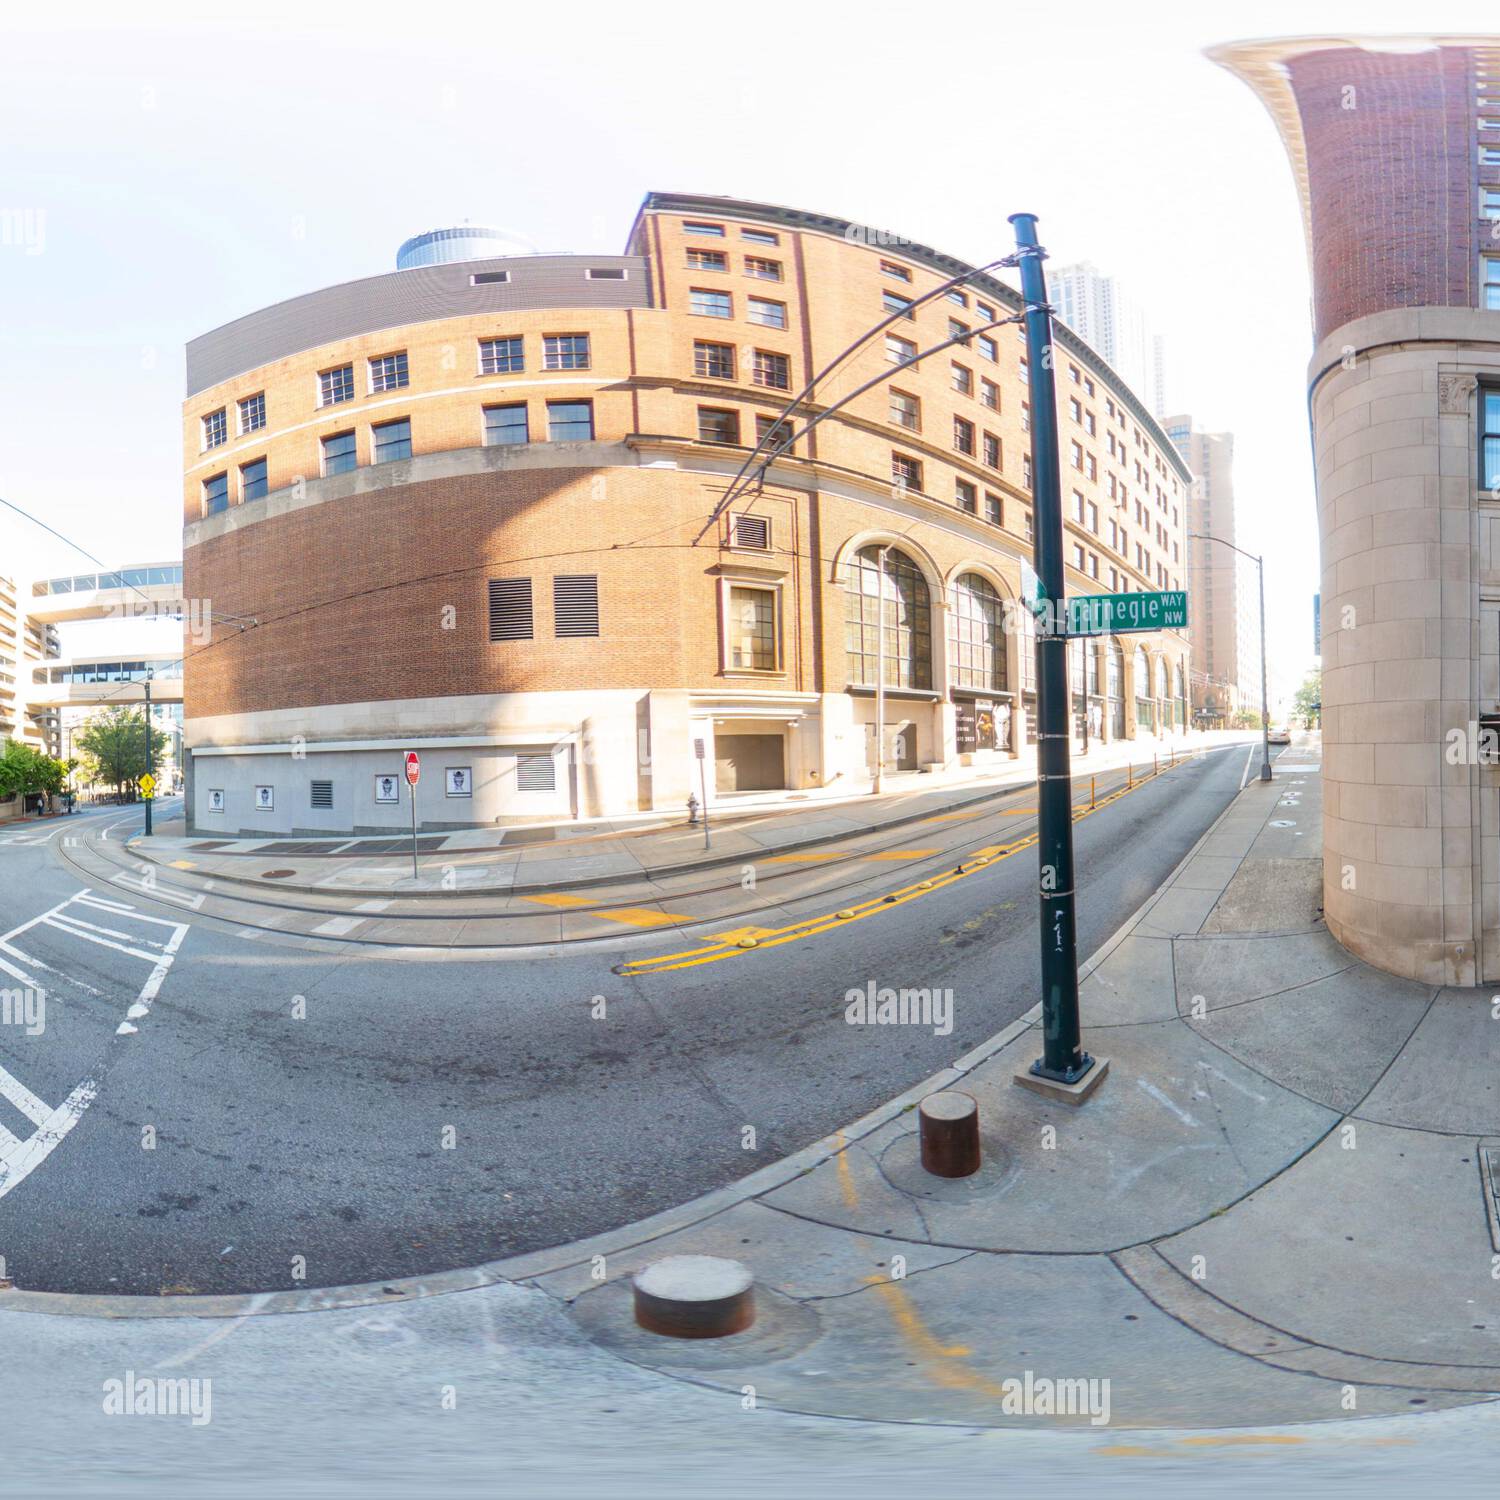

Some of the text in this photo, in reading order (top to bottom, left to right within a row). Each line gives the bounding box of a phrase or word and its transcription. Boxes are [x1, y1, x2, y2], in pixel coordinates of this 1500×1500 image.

[1070, 594, 1183, 626] Carnegie WAY
[1164, 611, 1183, 624] NW
